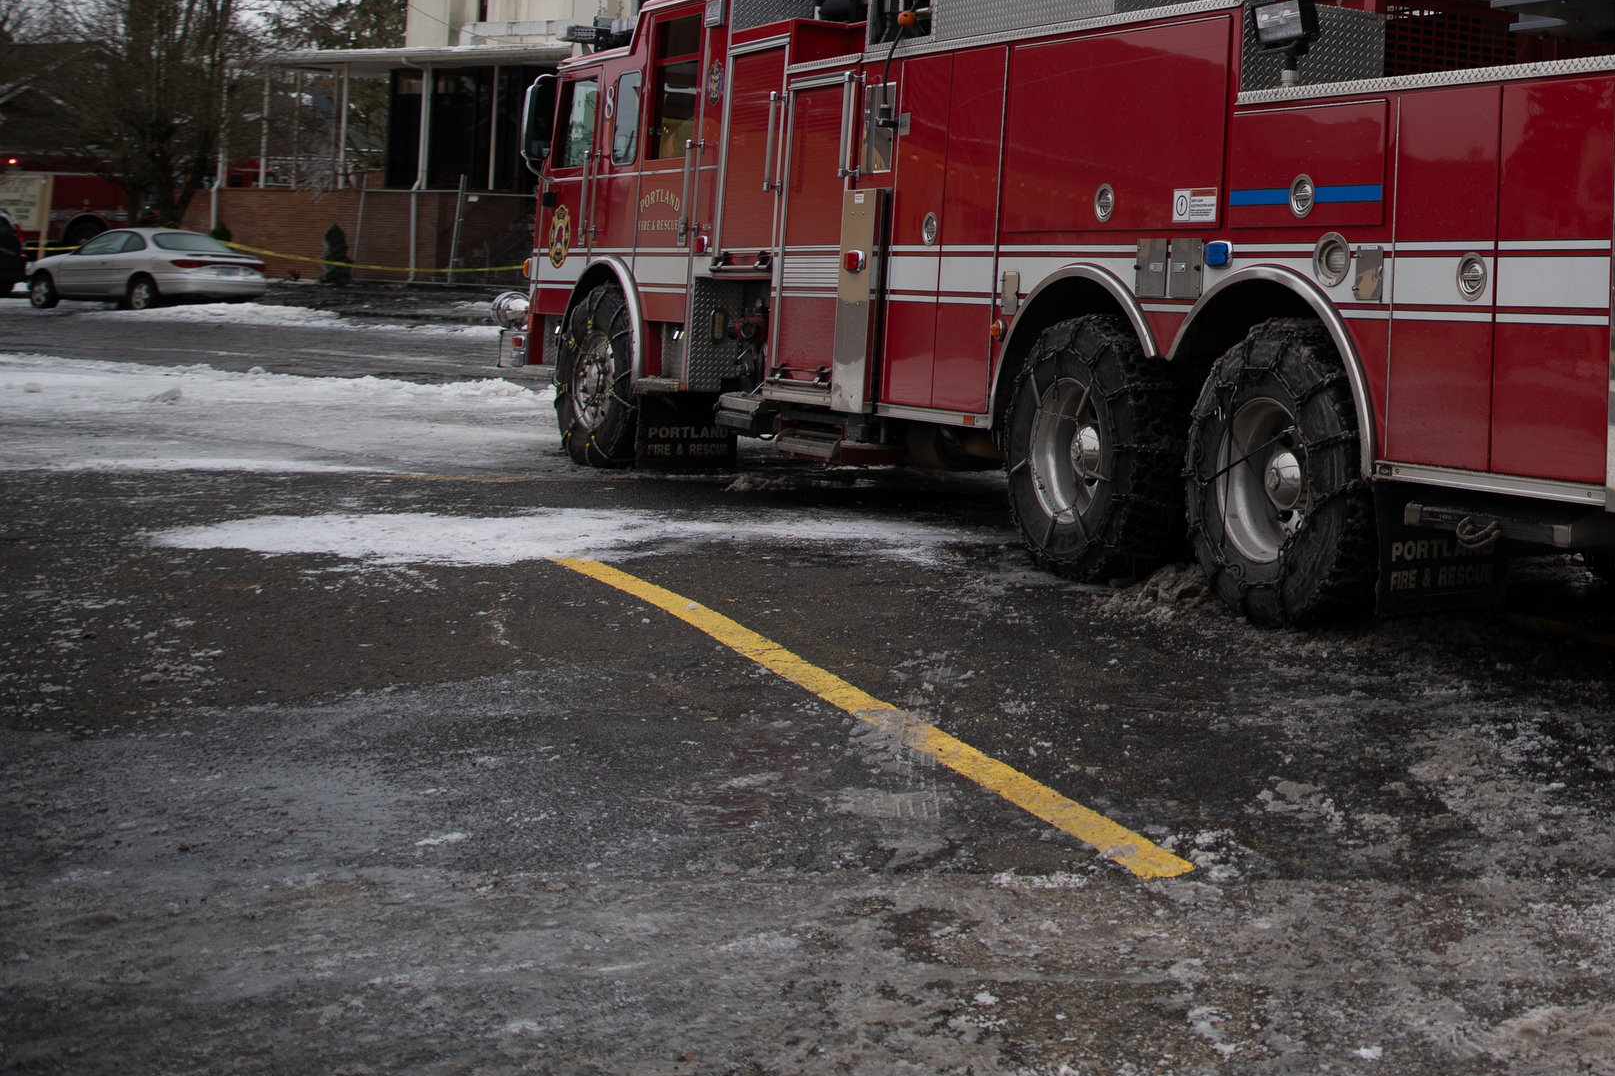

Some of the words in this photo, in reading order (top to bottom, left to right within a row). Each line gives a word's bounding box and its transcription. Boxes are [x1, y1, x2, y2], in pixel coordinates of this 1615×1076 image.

[604, 86, 615, 122] 8
[639, 188, 681, 213] PORTLAND
[638, 219, 650, 231] FIRE
[651, 219, 656, 231] &
[656, 219, 679, 231] RESCUE
[648, 426, 729, 439] PORTLAND
[647, 443, 671, 456] FIRE
[676, 443, 684, 456] &
[689, 443, 729, 456] RESCUE
[1390, 568, 1418, 591] FIRE
[1422, 567, 1431, 588] &
[1438, 563, 1494, 587] RESCUE
